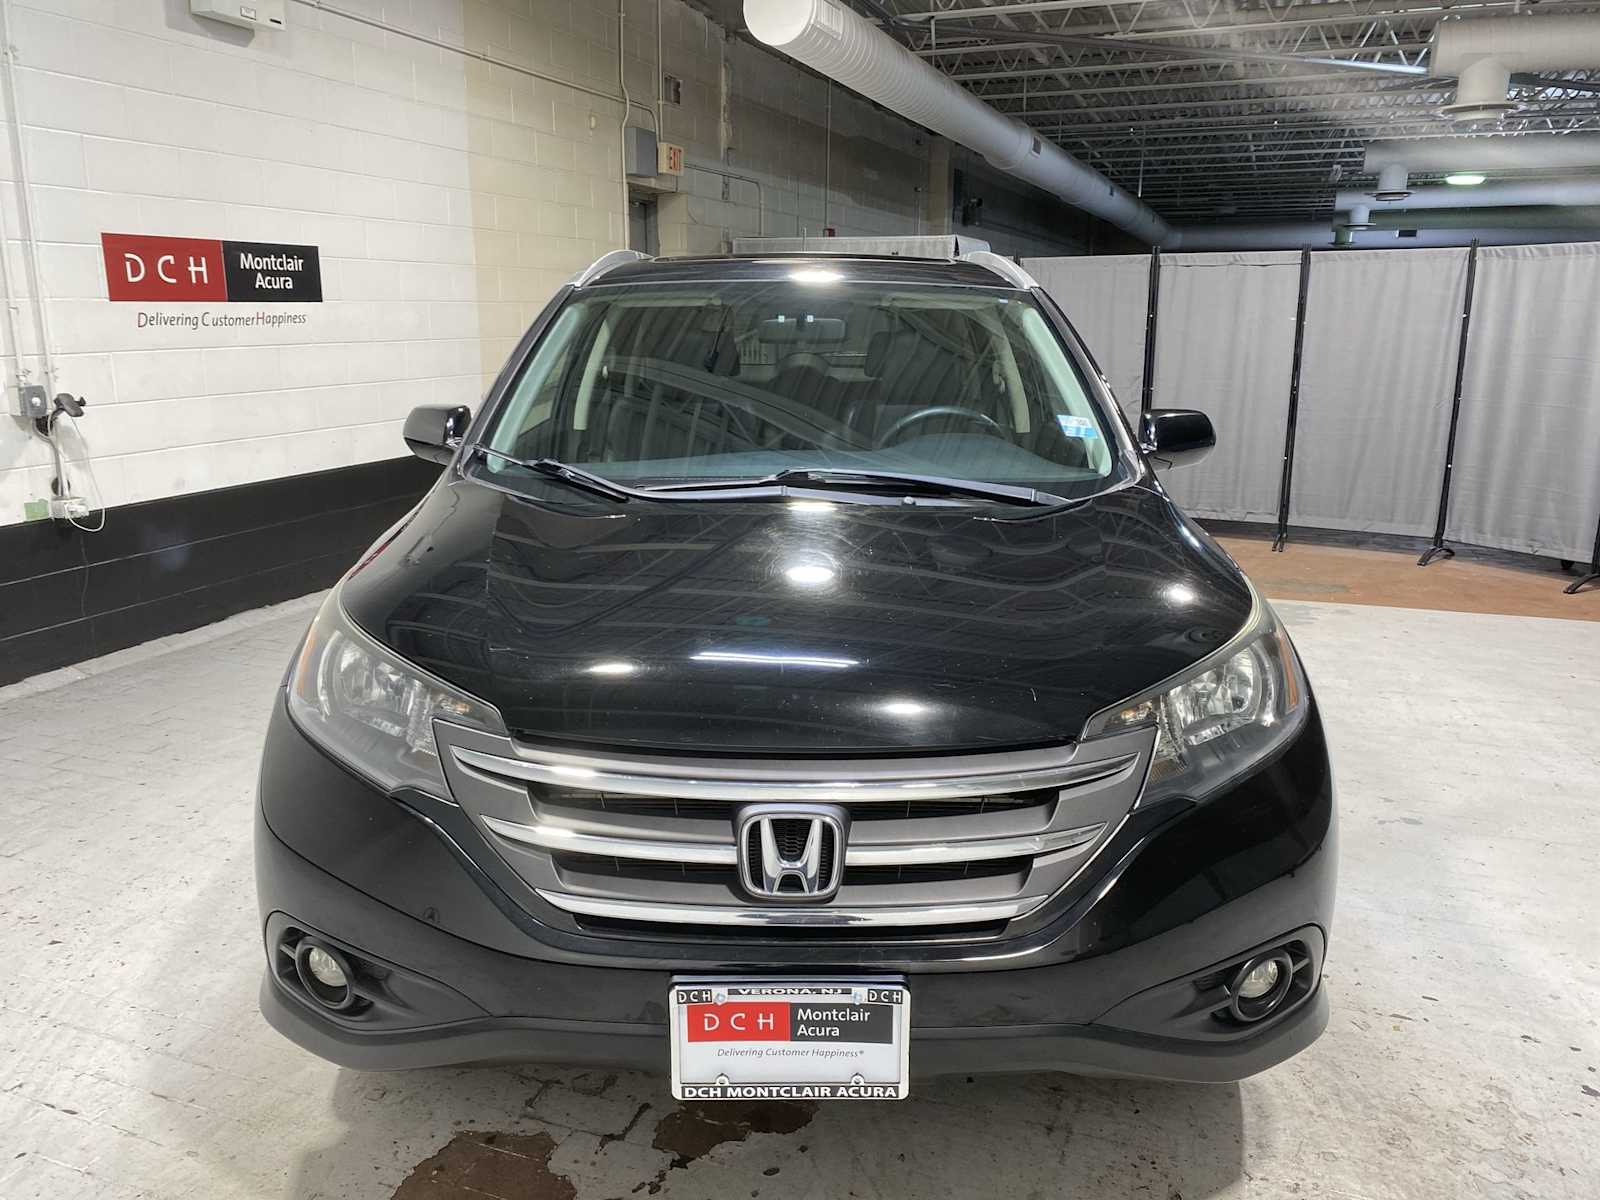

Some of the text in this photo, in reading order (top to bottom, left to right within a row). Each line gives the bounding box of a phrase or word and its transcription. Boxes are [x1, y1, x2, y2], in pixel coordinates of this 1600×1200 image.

[124, 252, 208, 284] DCH
[240, 252, 304, 271] Montclair
[255, 273, 293, 289] Acura
[137, 312, 199, 330] Delivering
[678, 990, 711, 1003] DCH
[869, 990, 902, 1003] DCH
[797, 1008, 870, 1021] Montclair
[704, 1013, 774, 1031] DCH
[797, 1024, 840, 1036] Acura
[717, 1048, 763, 1058] Delivering
[765, 1048, 809, 1057] Customer
[684, 1086, 897, 1098] DCH MONTCLAIR ACURA
